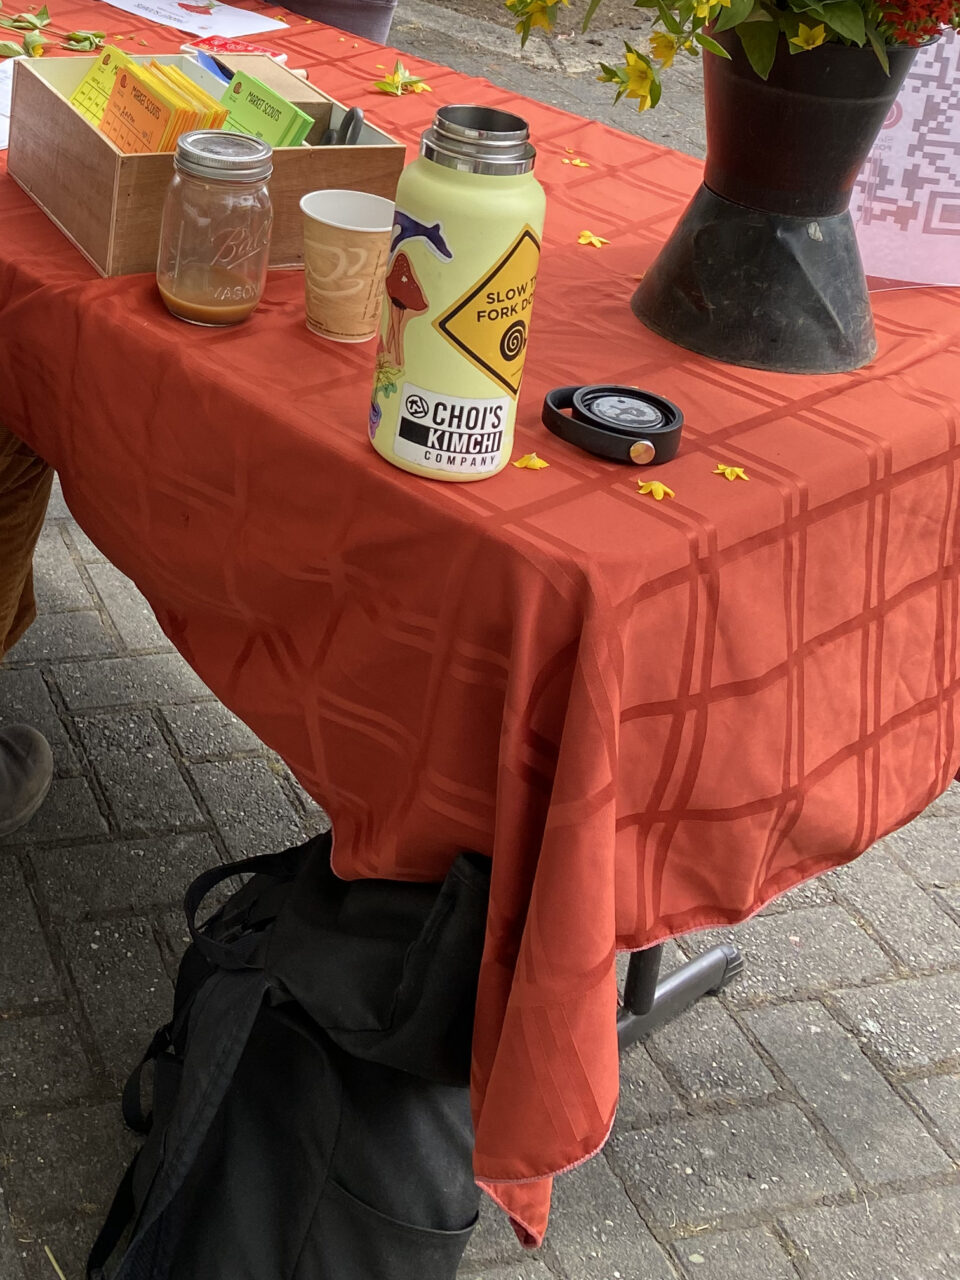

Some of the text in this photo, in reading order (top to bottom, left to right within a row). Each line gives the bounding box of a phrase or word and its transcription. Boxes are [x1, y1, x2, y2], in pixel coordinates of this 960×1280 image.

[245, 91, 283, 122] MARKET SCOUTS
[486, 282, 528, 305] SLOW
[476, 302, 519, 323] FORK
[432, 401, 503, 431] CHOI'S
[426, 428, 500, 454] KIMCHI
[424, 450, 496, 467] COMPANY
